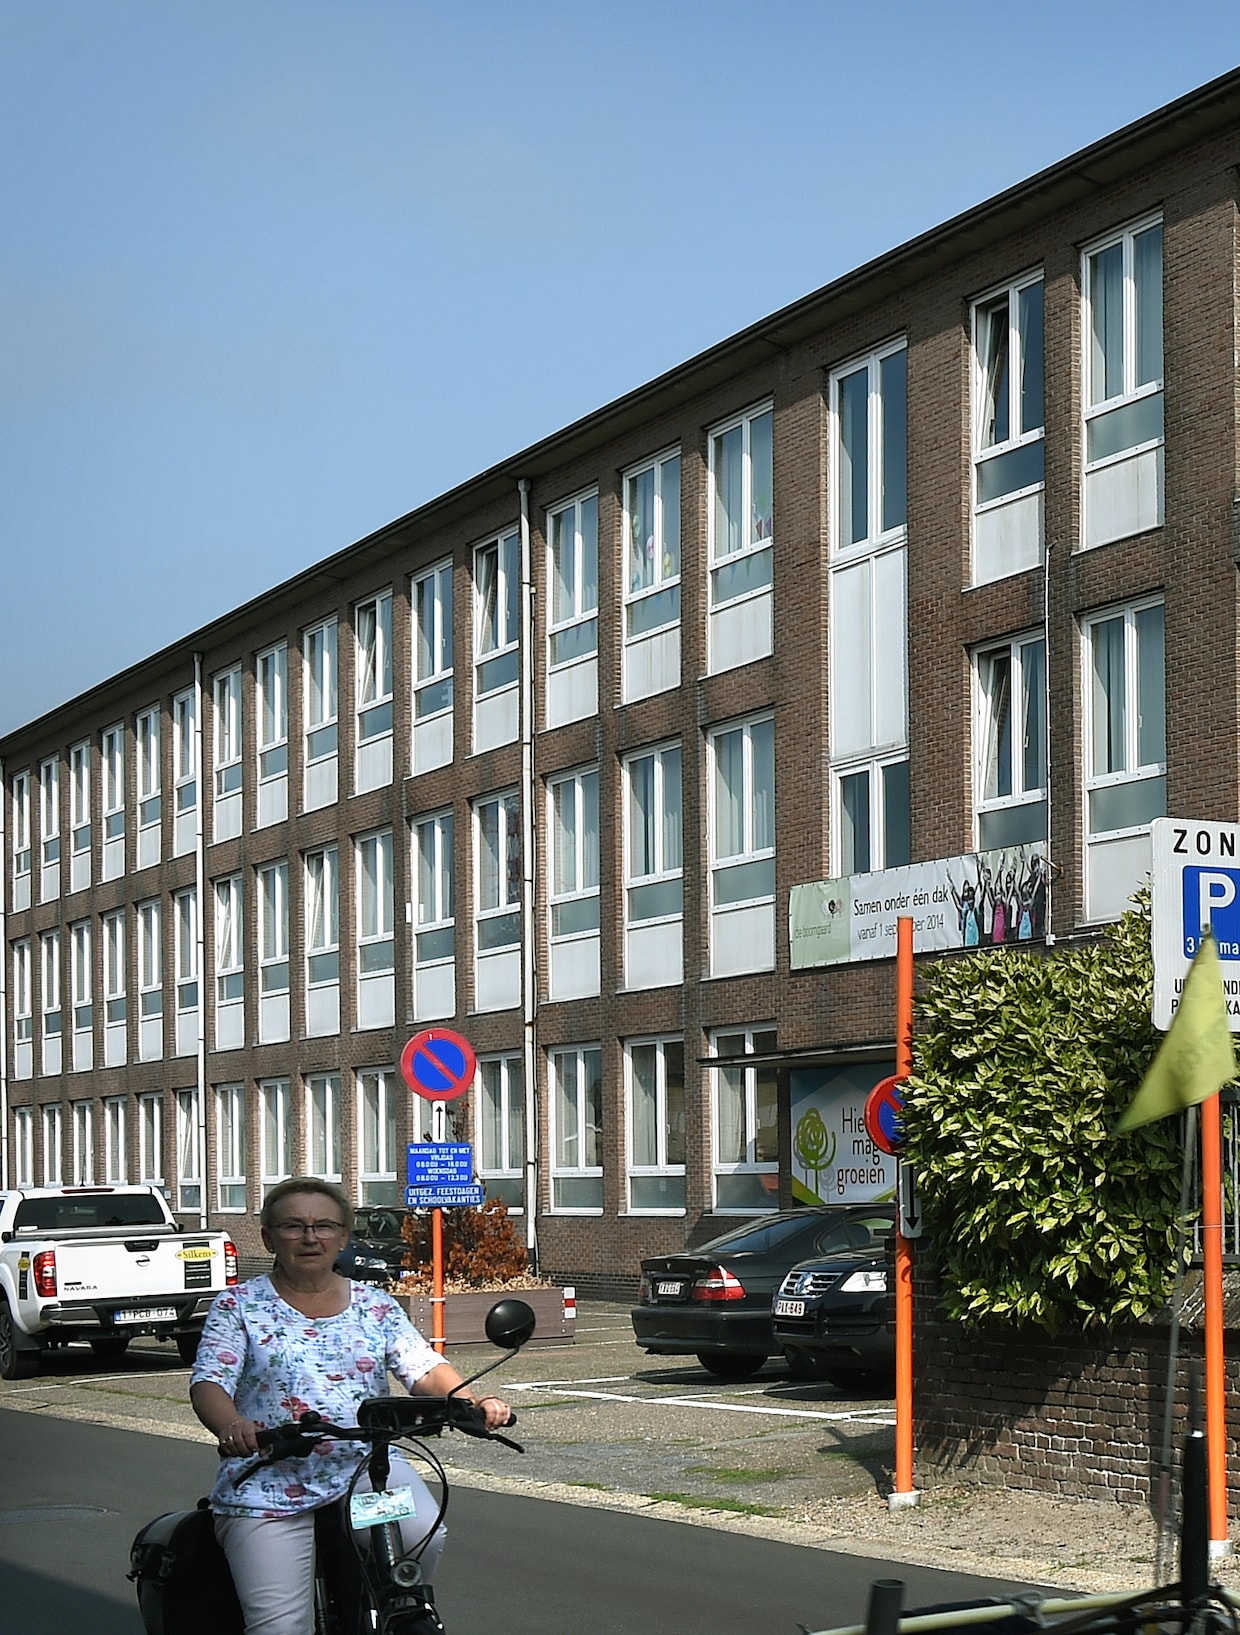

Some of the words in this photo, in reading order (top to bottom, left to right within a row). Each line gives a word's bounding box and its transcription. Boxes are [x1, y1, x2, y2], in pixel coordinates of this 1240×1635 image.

[854, 899, 882, 915] Samen
[884, 892, 910, 911] onder
[913, 888, 929, 906] één
[932, 884, 948, 903] dak
[1199, 872, 1236, 932] P
[857, 922, 878, 940] vanaf
[884, 918, 925, 939] seper
[926, 914, 944, 930] 2014
[842, 1107, 866, 1133] Hie
[852, 1139, 881, 1166] mag
[837, 1158, 885, 1195] groeien
[407, 1197, 418, 1205] EN
[418, 1195, 481, 1205] SCHOOLVAKANTIES
[436, 1187, 479, 1196] FEESTDAGEN
[183, 1250, 211, 1259] Silkens
